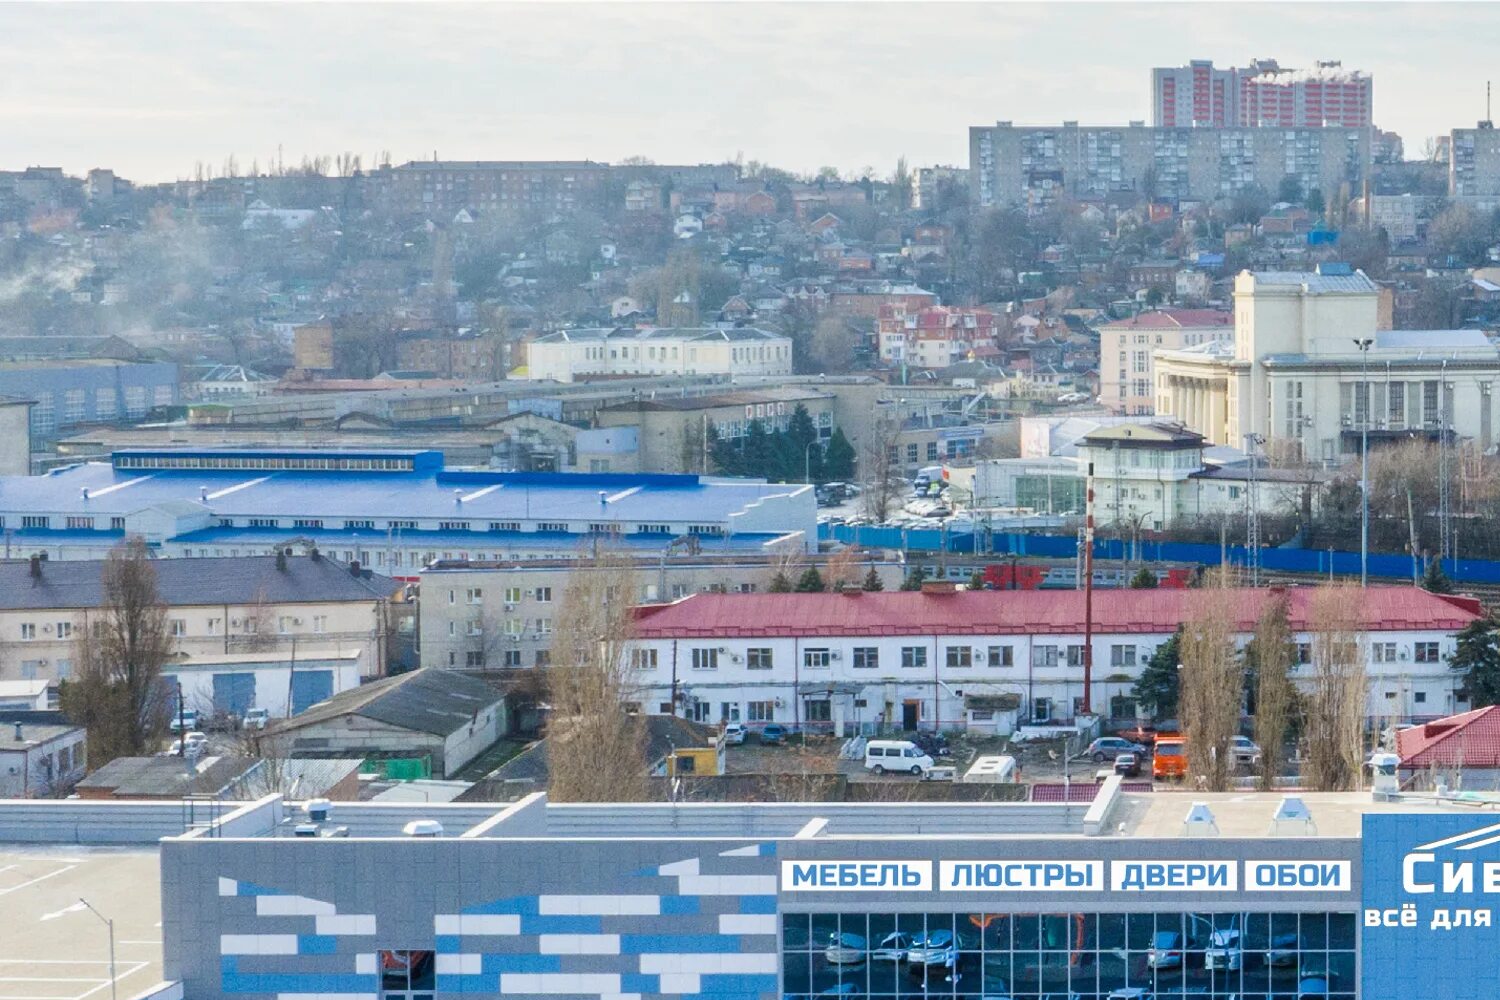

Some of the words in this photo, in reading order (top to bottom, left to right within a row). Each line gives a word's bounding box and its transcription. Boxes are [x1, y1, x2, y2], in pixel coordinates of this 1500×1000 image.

[792, 863, 922, 887] МЕБЕЛЬ
[951, 863, 1094, 887] ЛЮСТРЫ
[1121, 863, 1229, 890] ДВЕРИ
[1255, 863, 1341, 887] ОБОИ
[1364, 903, 1417, 927] всё
[1430, 908, 1491, 930] для
